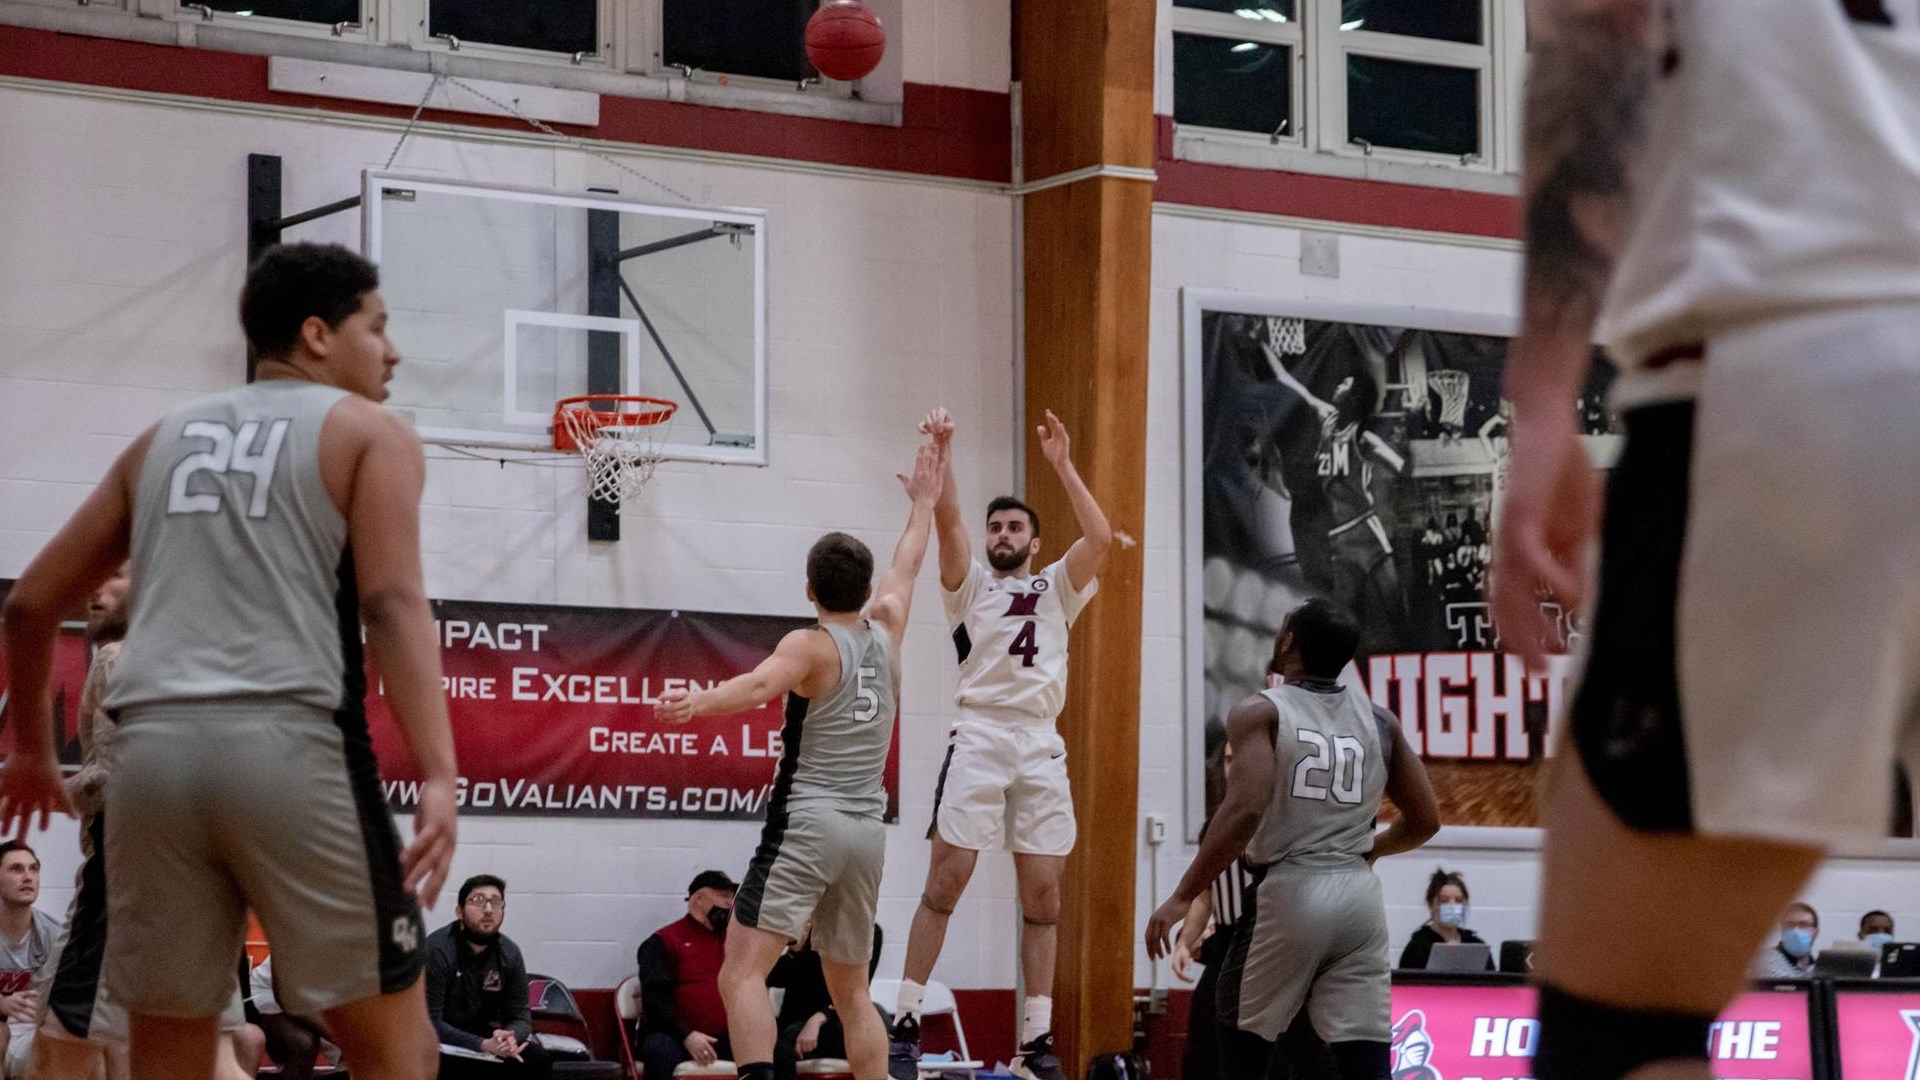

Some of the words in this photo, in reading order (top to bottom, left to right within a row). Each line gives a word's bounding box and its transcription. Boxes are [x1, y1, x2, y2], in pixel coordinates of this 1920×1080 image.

[167, 418, 292, 520] 24
[1333, 442, 1349, 476] M
[1003, 593, 1040, 617] M
[434, 619, 549, 651] PACT
[1008, 621, 1039, 667] 4
[512, 667, 767, 709] EXCELLEN
[854, 666, 879, 722] 5
[590, 727, 698, 755] CREATE
[709, 735, 729, 756] A
[742, 724, 783, 757] LE
[1290, 728, 1365, 804] 20
[1469, 1017, 1542, 1058] HO
